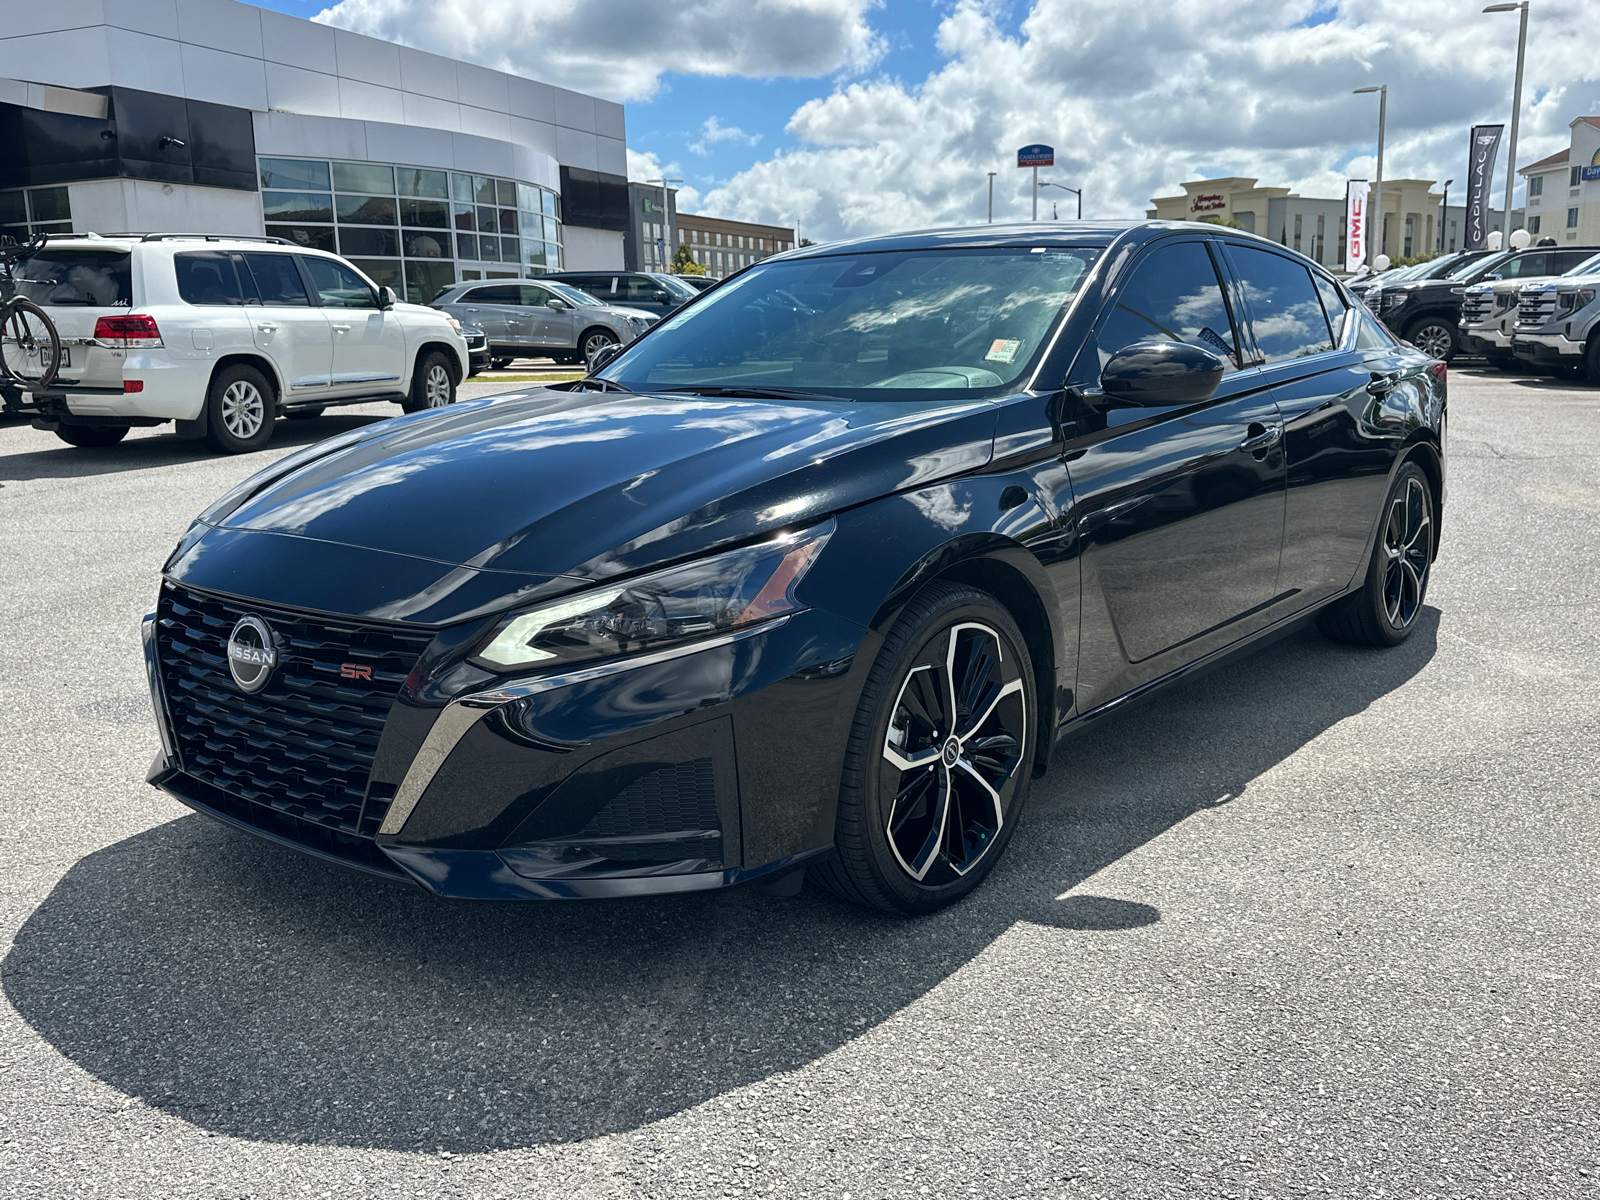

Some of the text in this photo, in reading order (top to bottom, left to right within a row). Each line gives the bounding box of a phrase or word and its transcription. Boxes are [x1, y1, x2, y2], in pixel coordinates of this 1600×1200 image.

[1473, 151, 1487, 242] CADILLAC
[1350, 199, 1362, 258] GMC
[228, 642, 274, 664] NISSAN
[340, 663, 372, 681] SR
